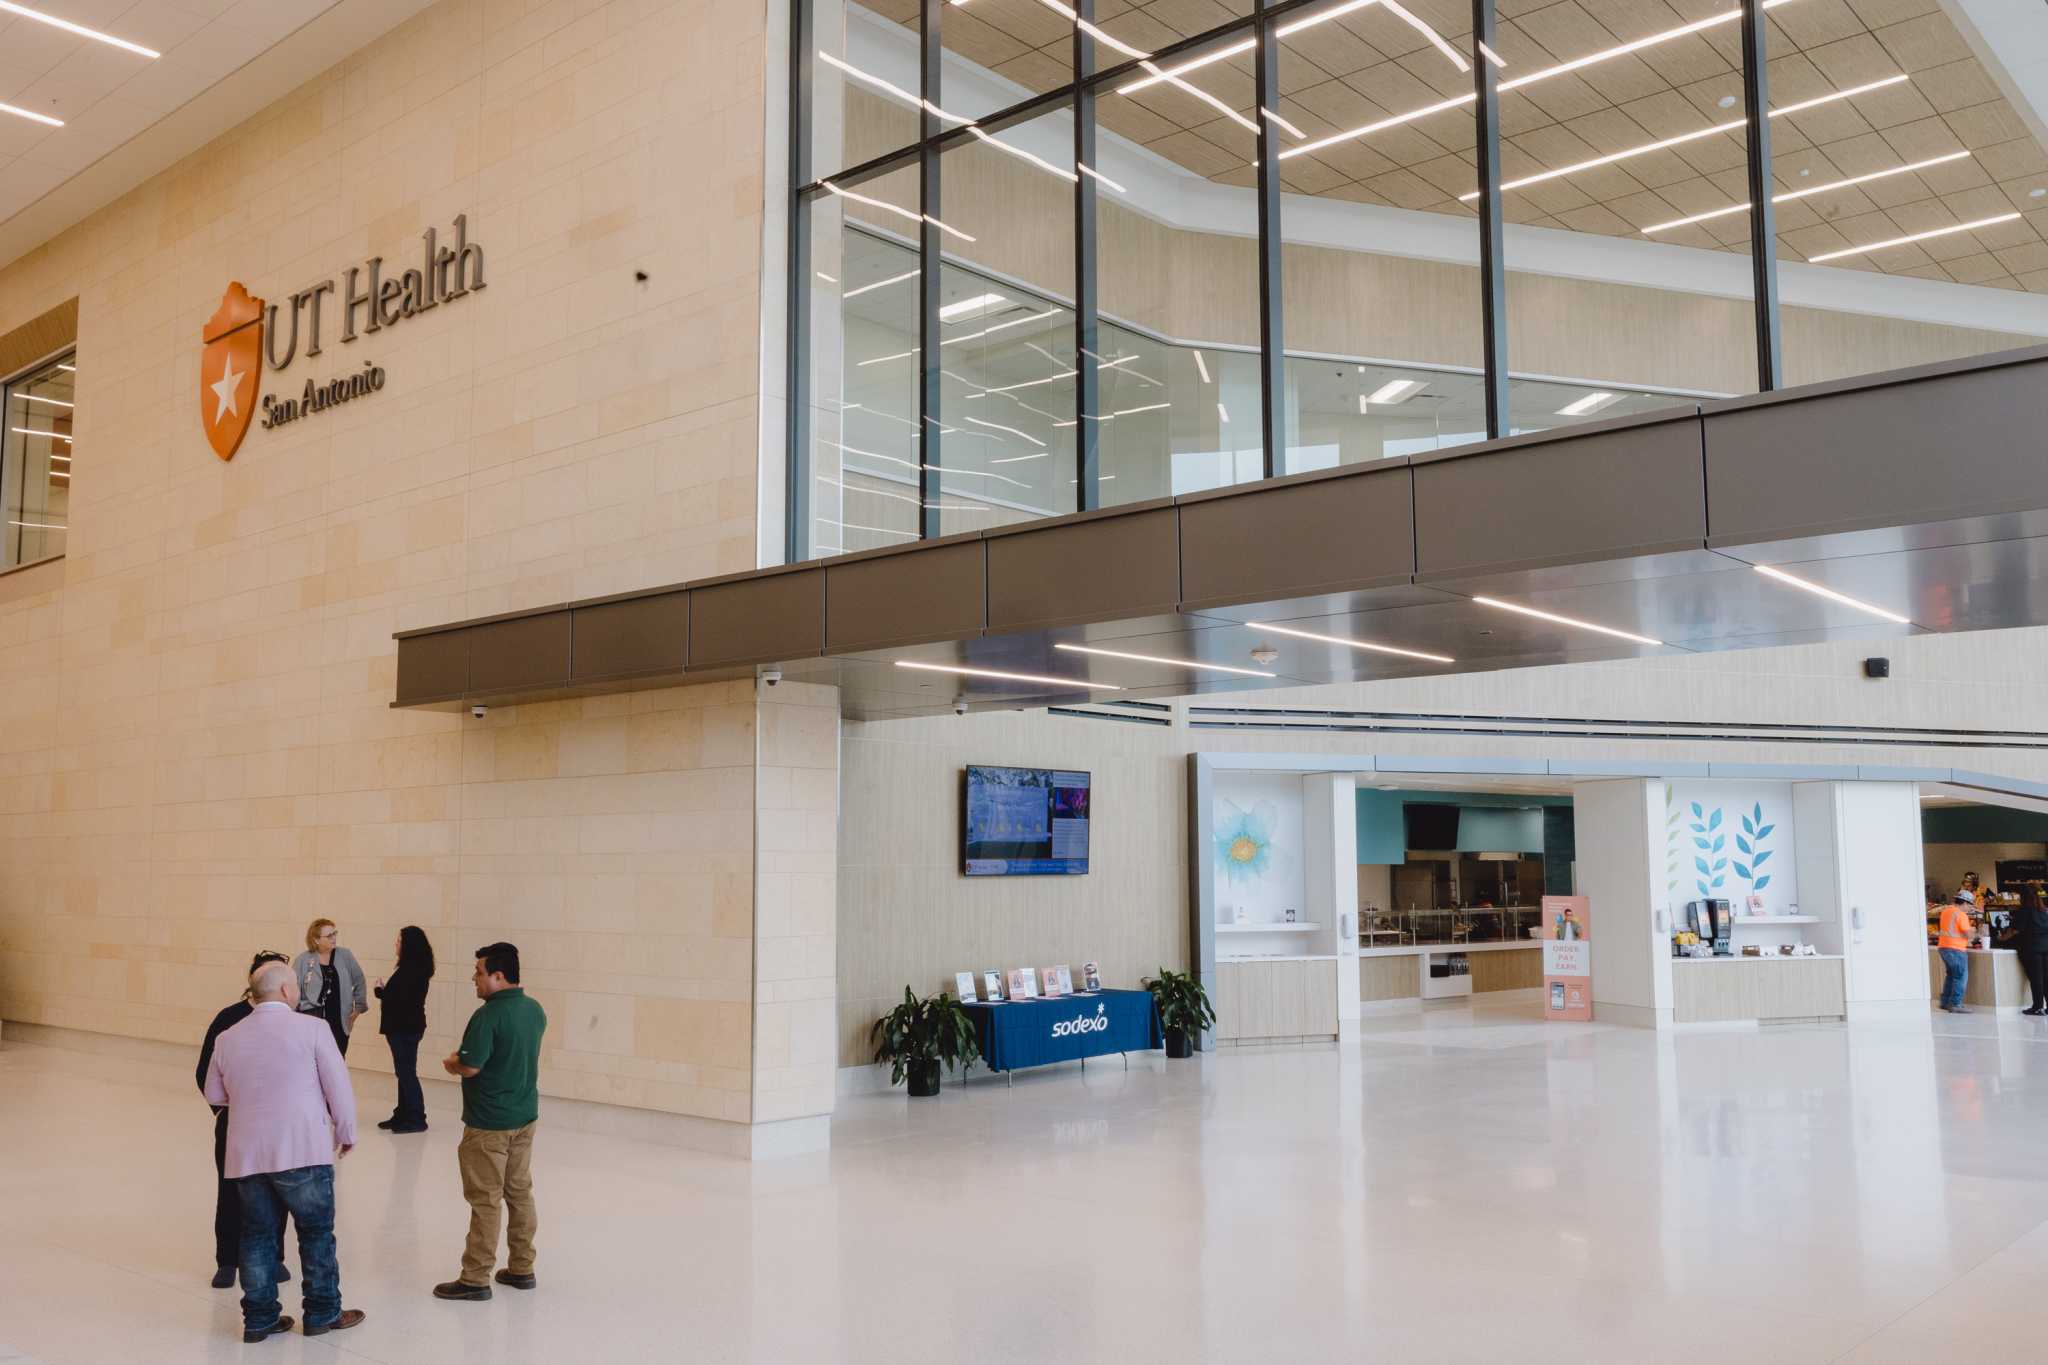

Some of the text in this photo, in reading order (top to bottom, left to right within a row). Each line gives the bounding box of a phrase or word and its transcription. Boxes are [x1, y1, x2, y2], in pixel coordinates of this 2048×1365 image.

[265, 214, 487, 370] UT Health
[262, 360, 385, 429] San Antonio
[1051, 1011, 1108, 1037] sodexo
